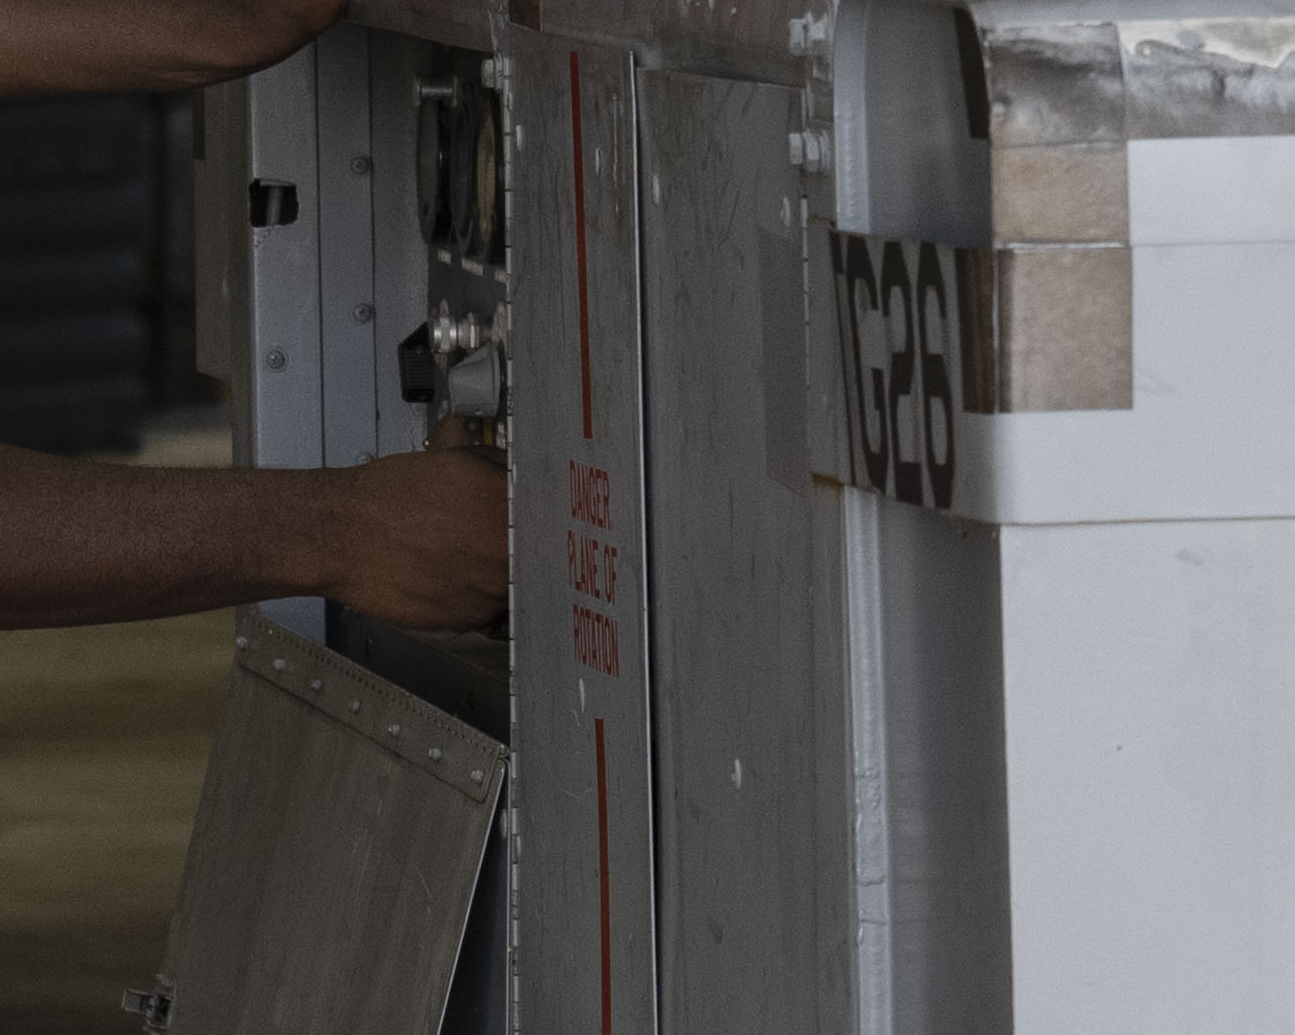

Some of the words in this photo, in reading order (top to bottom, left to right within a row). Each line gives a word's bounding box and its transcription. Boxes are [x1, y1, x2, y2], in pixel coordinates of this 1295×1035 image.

[570, 460, 611, 530] DANGER
[567, 530, 601, 600] PLANE
[604, 544, 618, 605] OF
[573, 604, 620, 678] ROTATION
